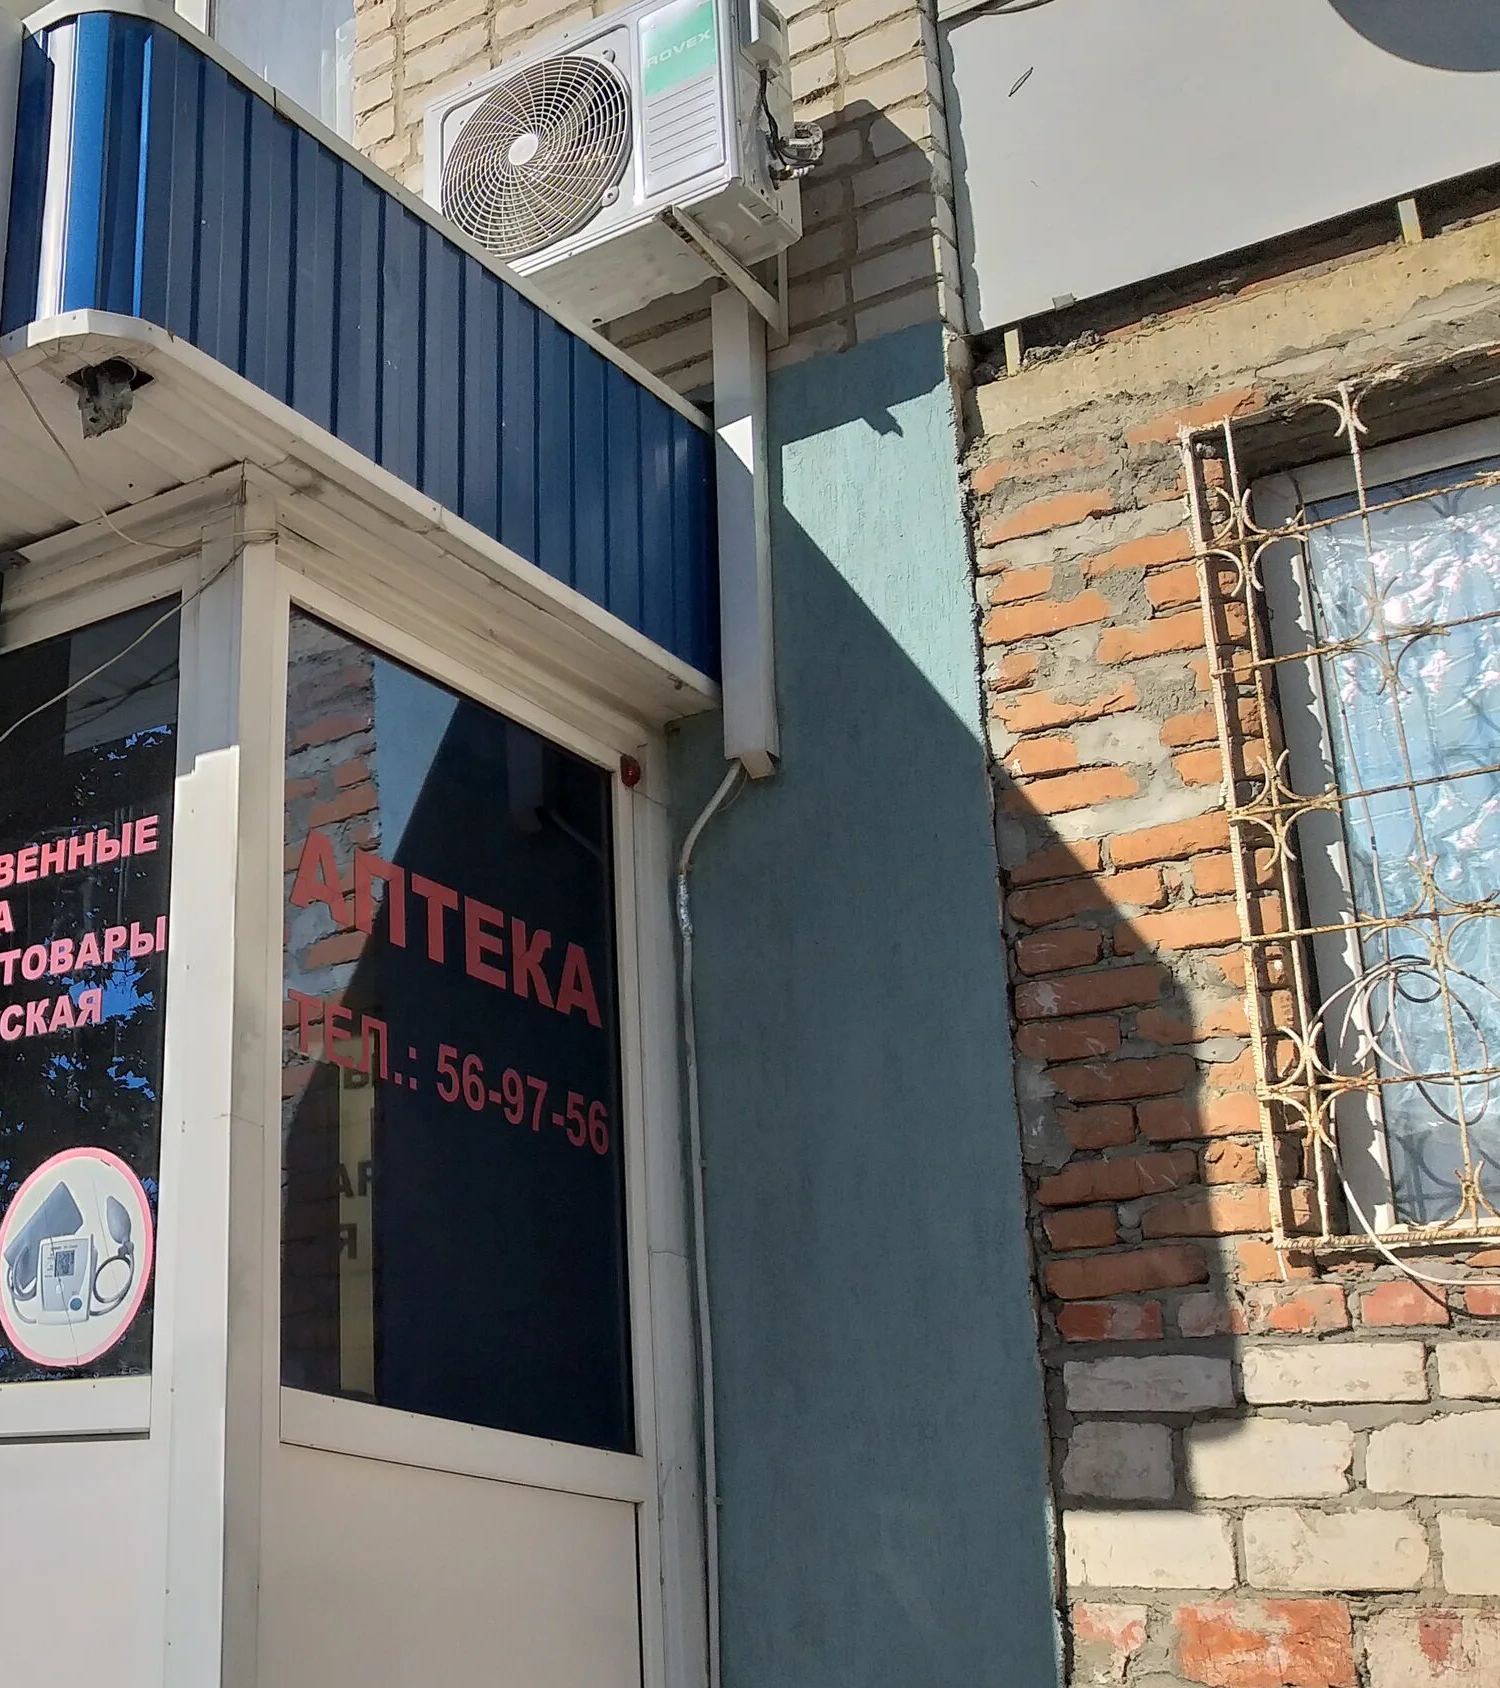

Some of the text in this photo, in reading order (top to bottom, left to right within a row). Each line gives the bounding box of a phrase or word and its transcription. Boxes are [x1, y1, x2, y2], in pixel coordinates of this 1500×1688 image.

[647, 28, 712, 68] ROVEX
[290, 830, 603, 1029] АПТЕКА
[287, 987, 610, 1156] ТЕЛ.: 56-97-56
